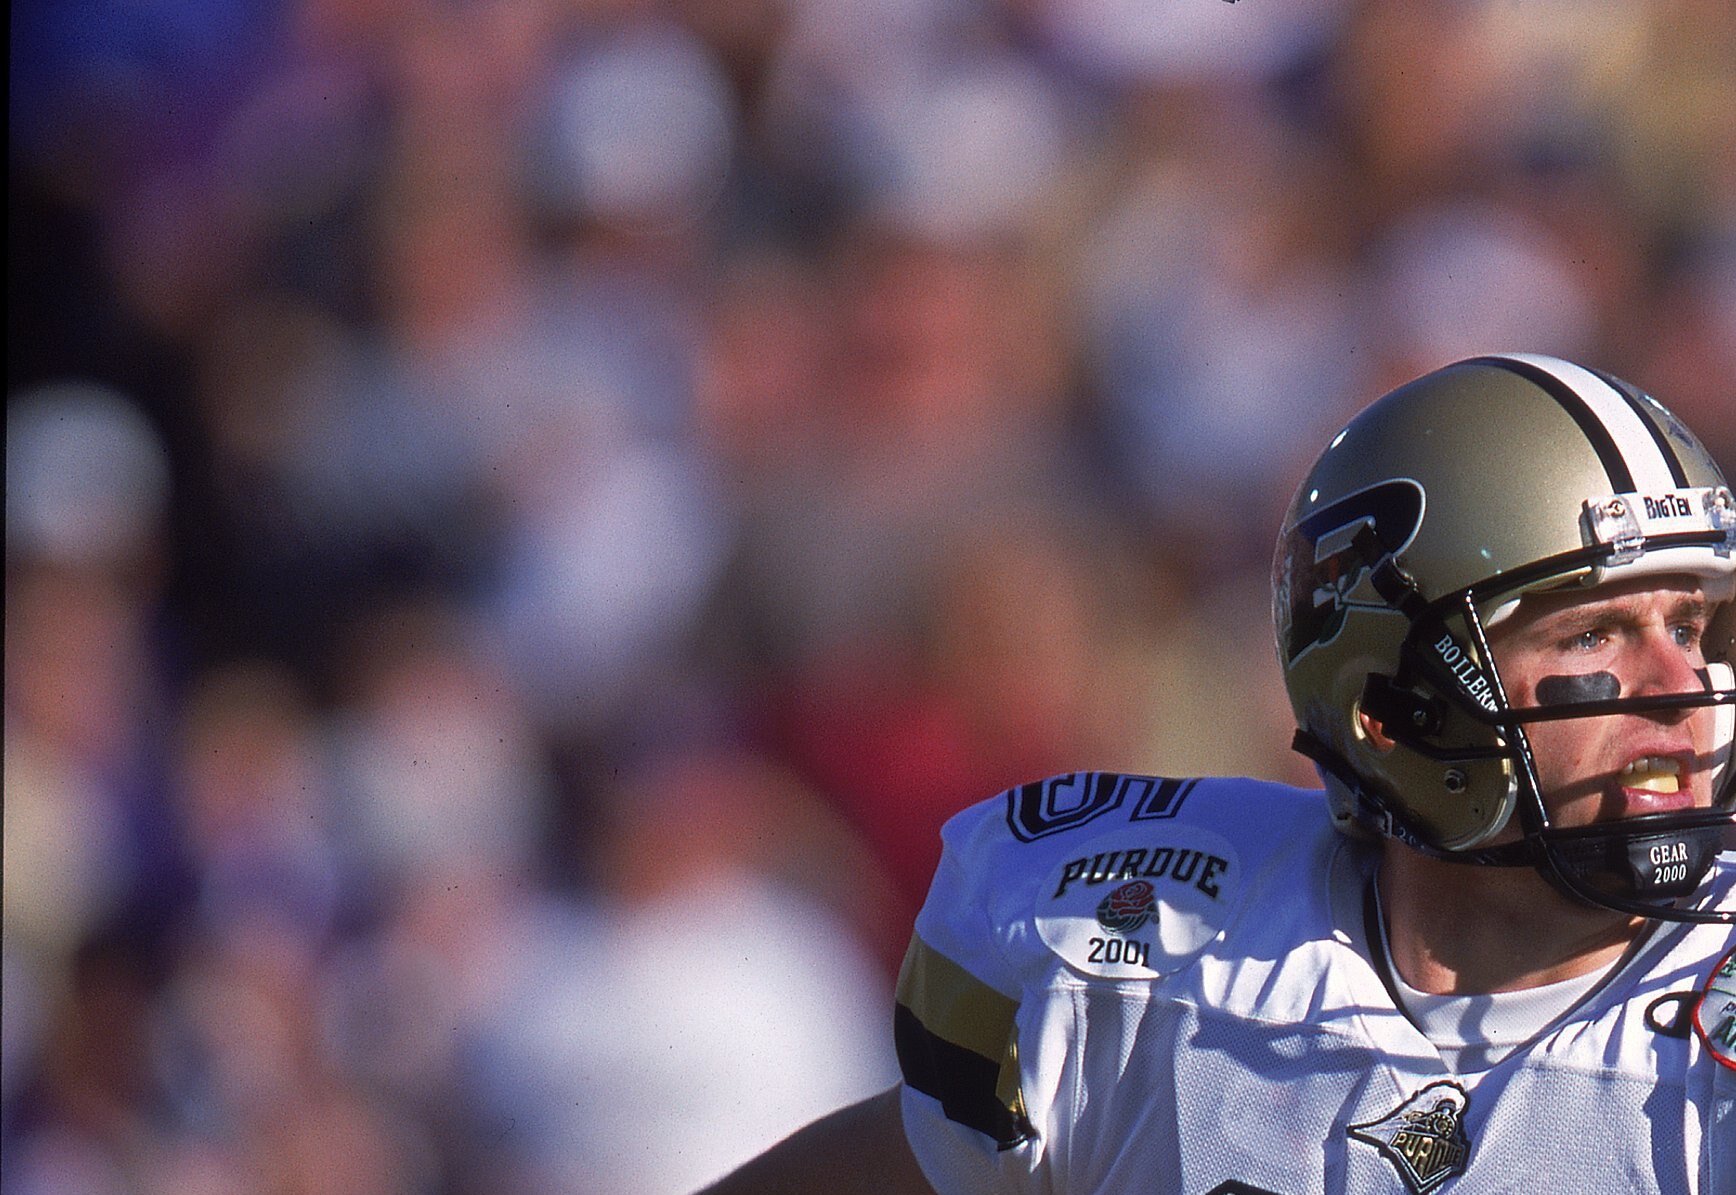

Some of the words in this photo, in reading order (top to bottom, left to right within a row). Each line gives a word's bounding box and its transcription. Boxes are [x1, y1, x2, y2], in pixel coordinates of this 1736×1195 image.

[1650, 842, 1688, 865] GEAR
[1053, 848, 1228, 899] PURDUE
[1654, 864, 1687, 884] 2000
[1088, 937, 1150, 967] 2001
